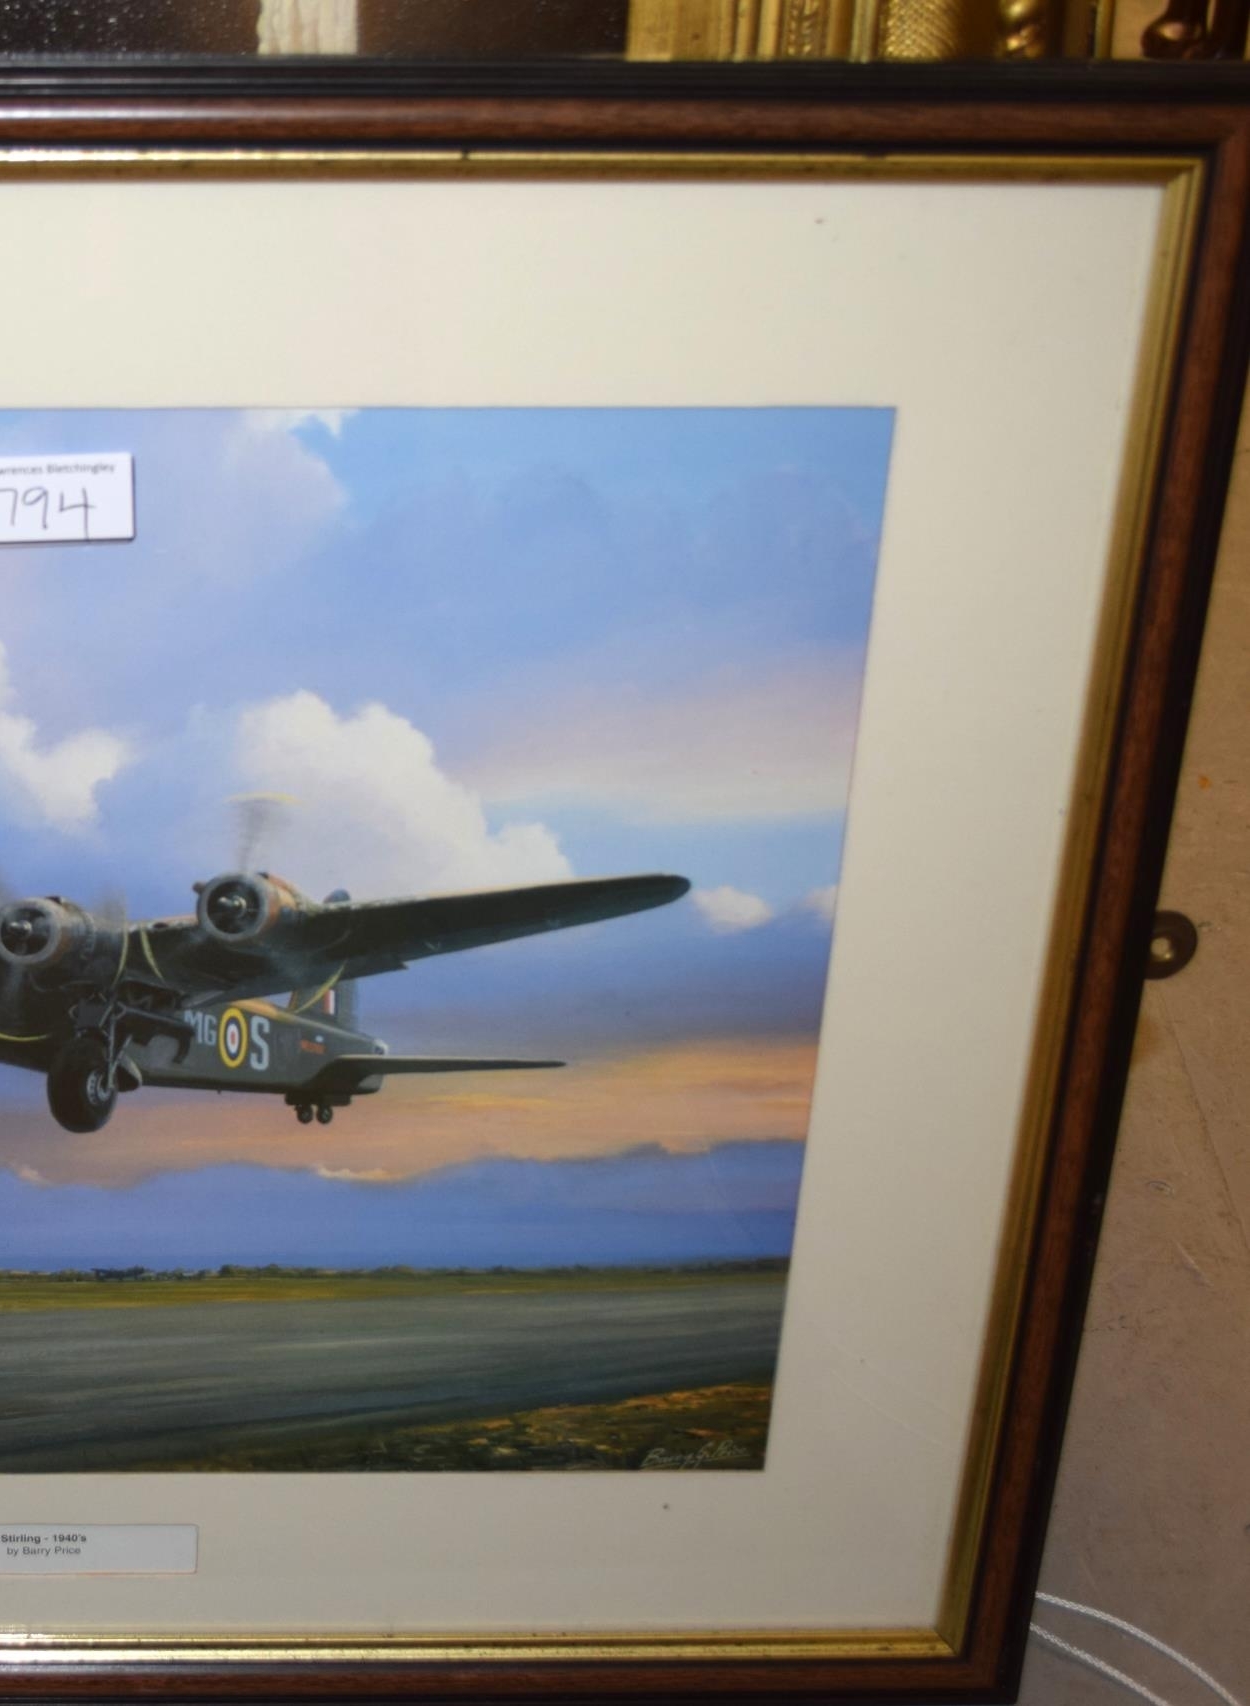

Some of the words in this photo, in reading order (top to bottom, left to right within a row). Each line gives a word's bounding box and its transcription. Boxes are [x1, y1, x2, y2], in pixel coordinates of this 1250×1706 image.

[251, 1014, 270, 1071] S
[0, 1533, 41, 1544] Stirling
[52, 1533, 87, 1543] 1940's
[6, 1546, 19, 1557] by
[22, 1546, 51, 1556] Barry
[54, 1545, 81, 1555] Price
